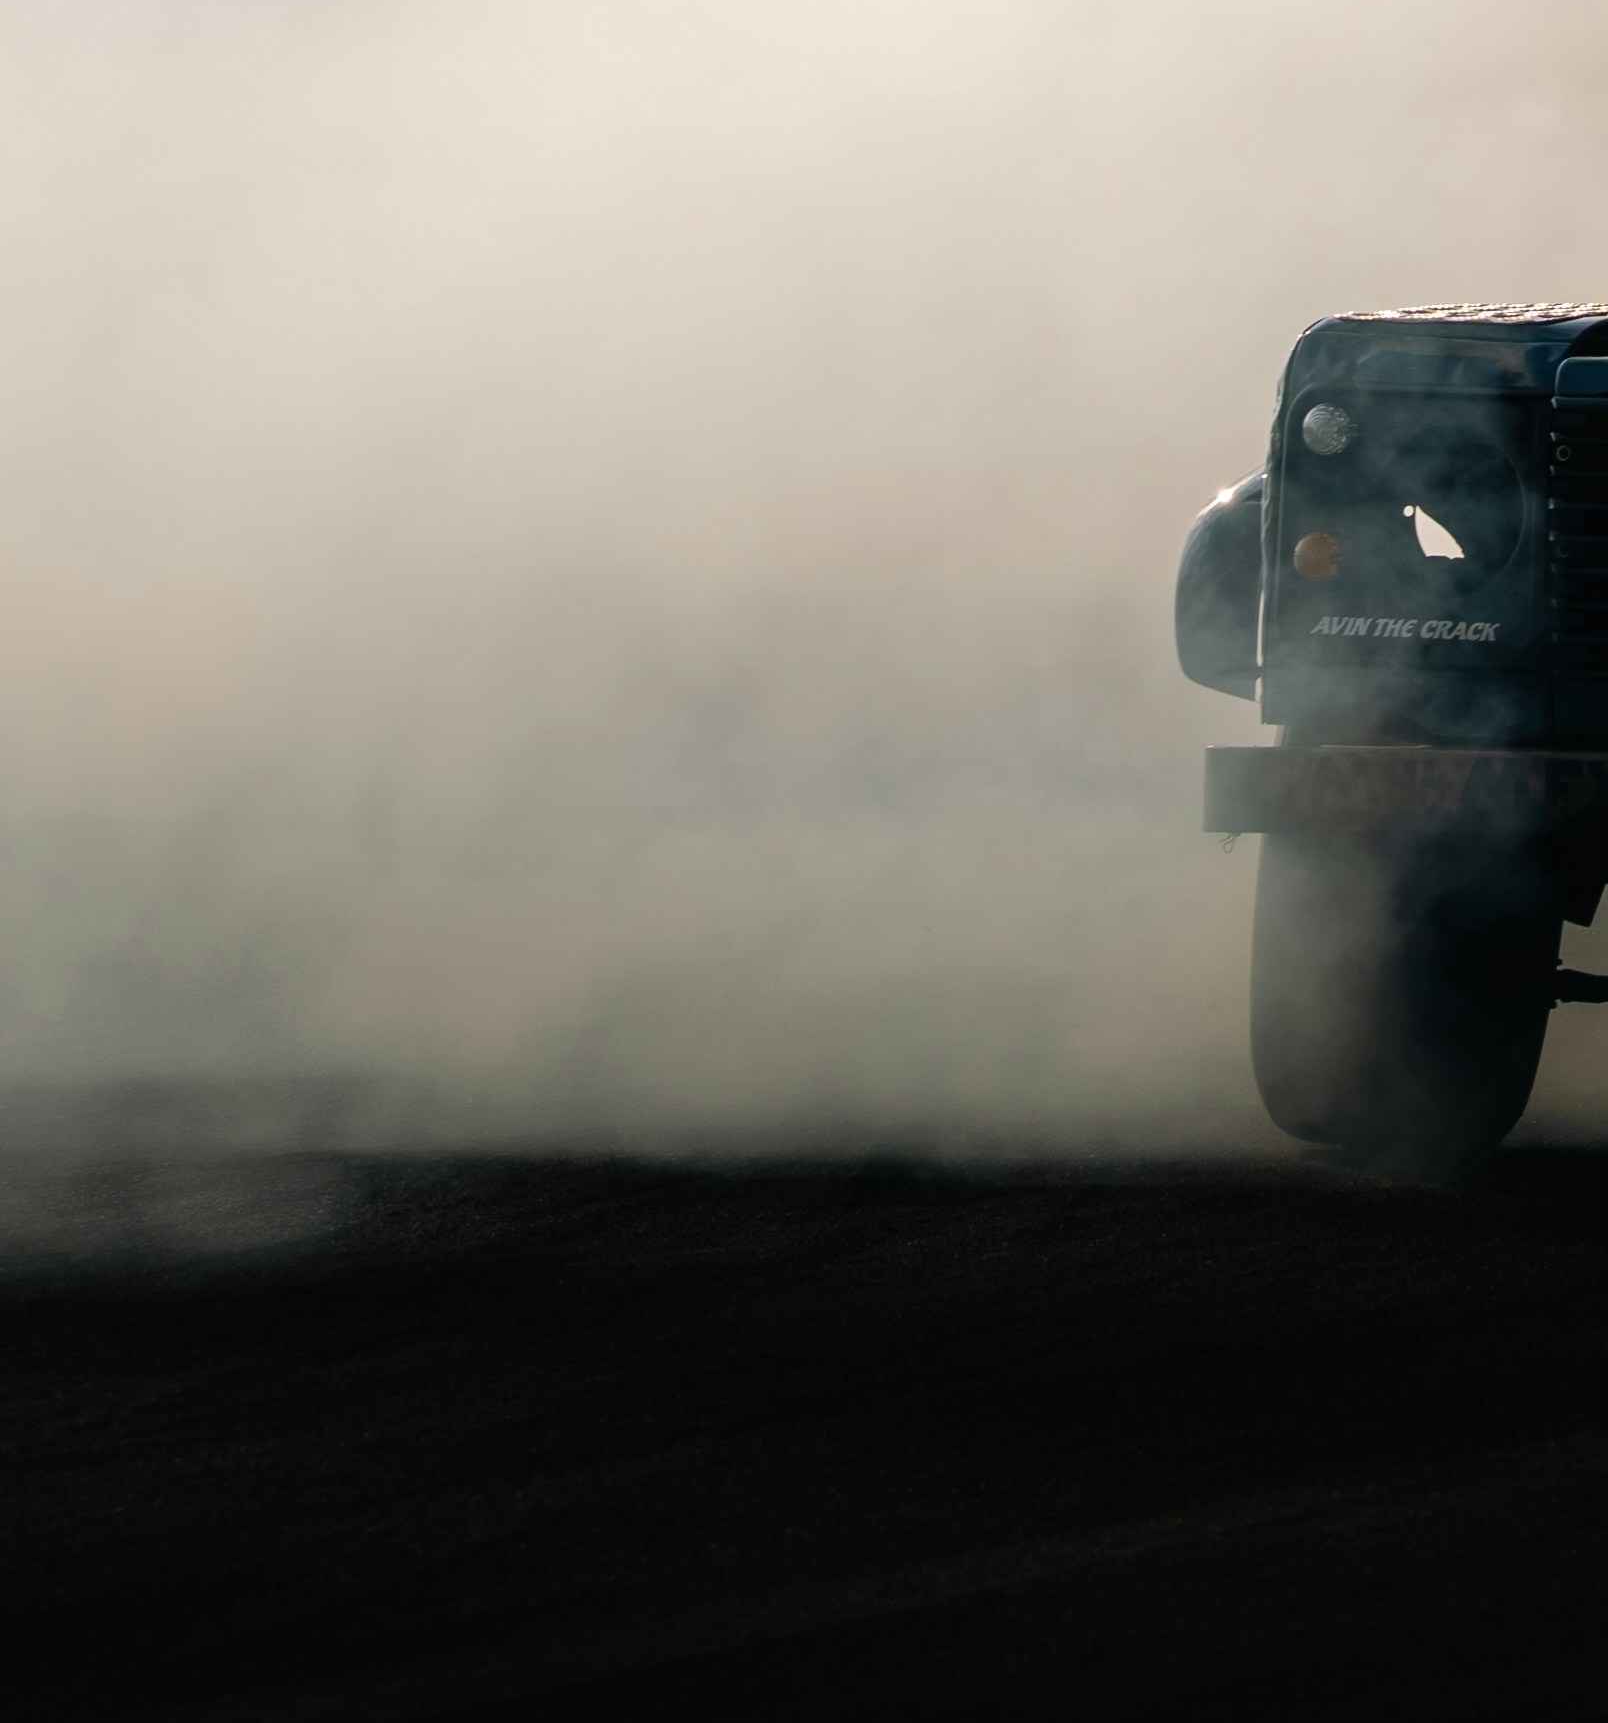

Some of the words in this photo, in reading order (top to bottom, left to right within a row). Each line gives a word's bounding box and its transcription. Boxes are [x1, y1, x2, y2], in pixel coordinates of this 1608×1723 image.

[1310, 615, 1373, 636] AVIN
[1373, 618, 1418, 638] THE
[1419, 619, 1500, 642] CRACK
